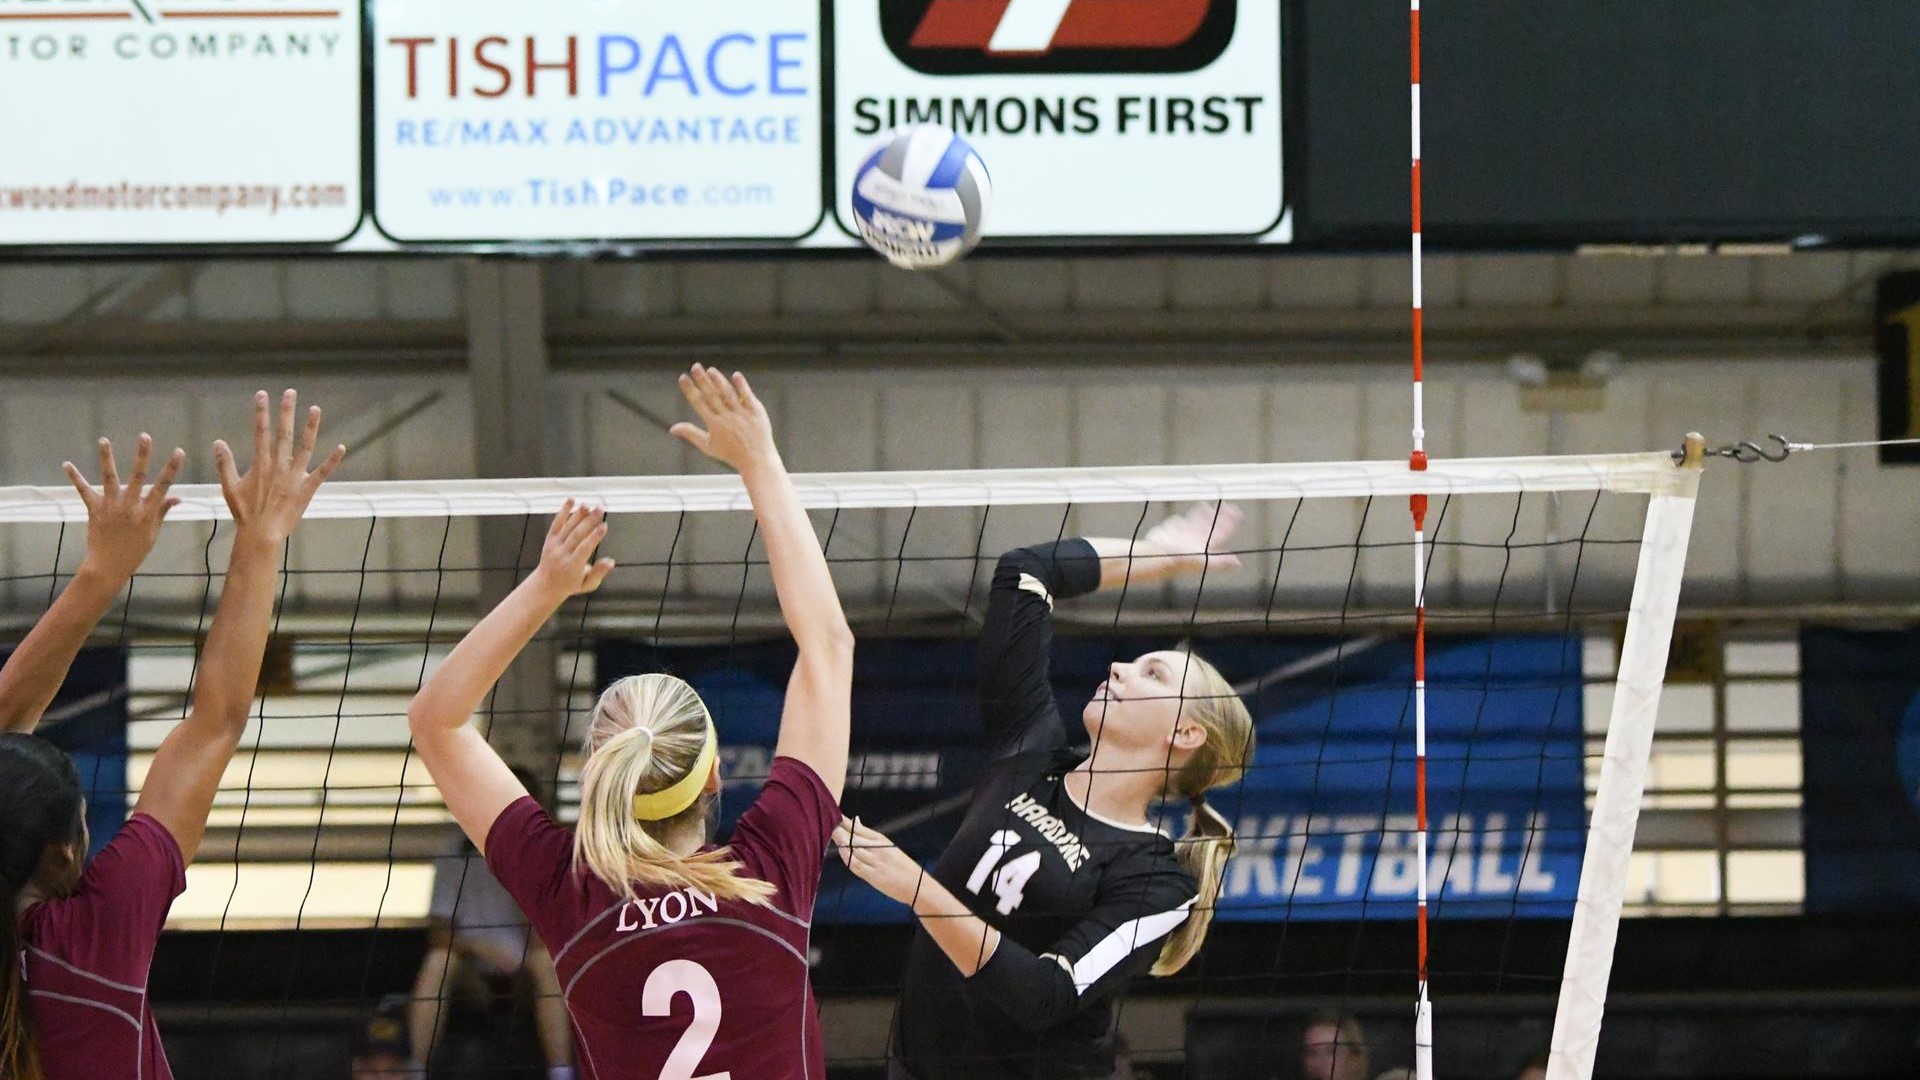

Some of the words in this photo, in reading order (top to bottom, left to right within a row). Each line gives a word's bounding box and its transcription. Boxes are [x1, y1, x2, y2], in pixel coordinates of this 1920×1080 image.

[113, 32, 341, 60] COMPANY
[396, 119, 549, 146] RE/MAX
[564, 117, 801, 144] ADVANTAGE
[853, 96, 1099, 136] SIMMONS
[1116, 96, 1263, 134] FIRST
[0, 179, 346, 215] woodmotorcompany.com
[428, 179, 774, 207] www.TishPace.com
[1005, 791, 1091, 873] HARDING
[965, 829, 1042, 916] 14
[1226, 812, 1557, 897] KETBALL
[616, 886, 718, 932] LYON
[641, 959, 732, 1080] 2
